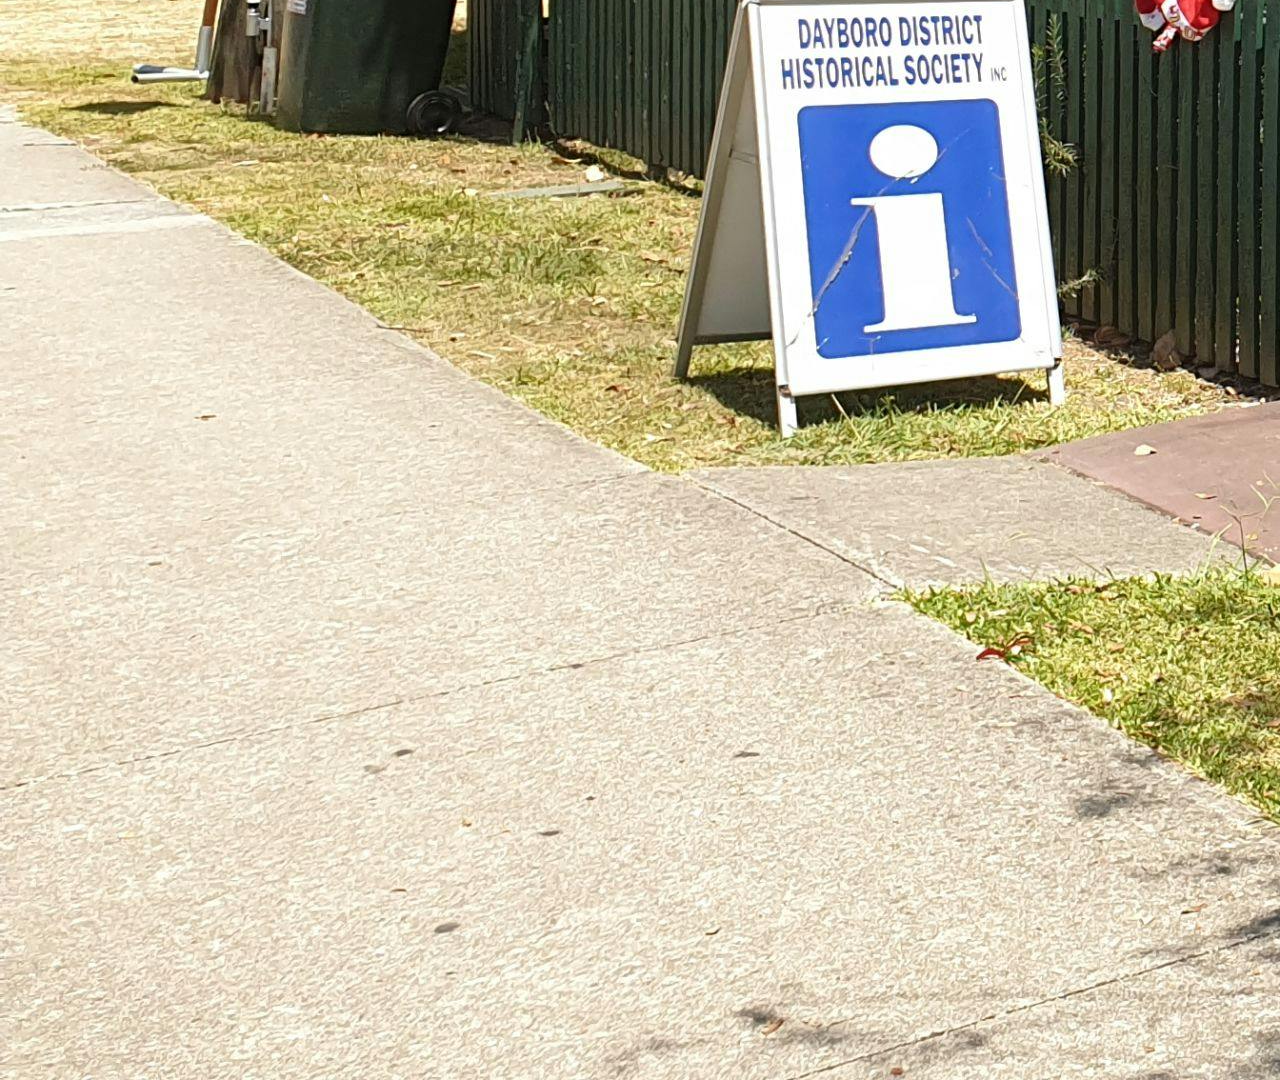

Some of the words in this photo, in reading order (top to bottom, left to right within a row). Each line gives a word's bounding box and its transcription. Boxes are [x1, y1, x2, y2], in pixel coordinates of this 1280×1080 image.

[798, 16, 893, 49] DAYBORO
[899, 14, 983, 47] DISTRICT
[780, 55, 899, 90] HISTORICAL
[904, 52, 984, 85] SOCIETY
[990, 66, 1008, 82] INC
